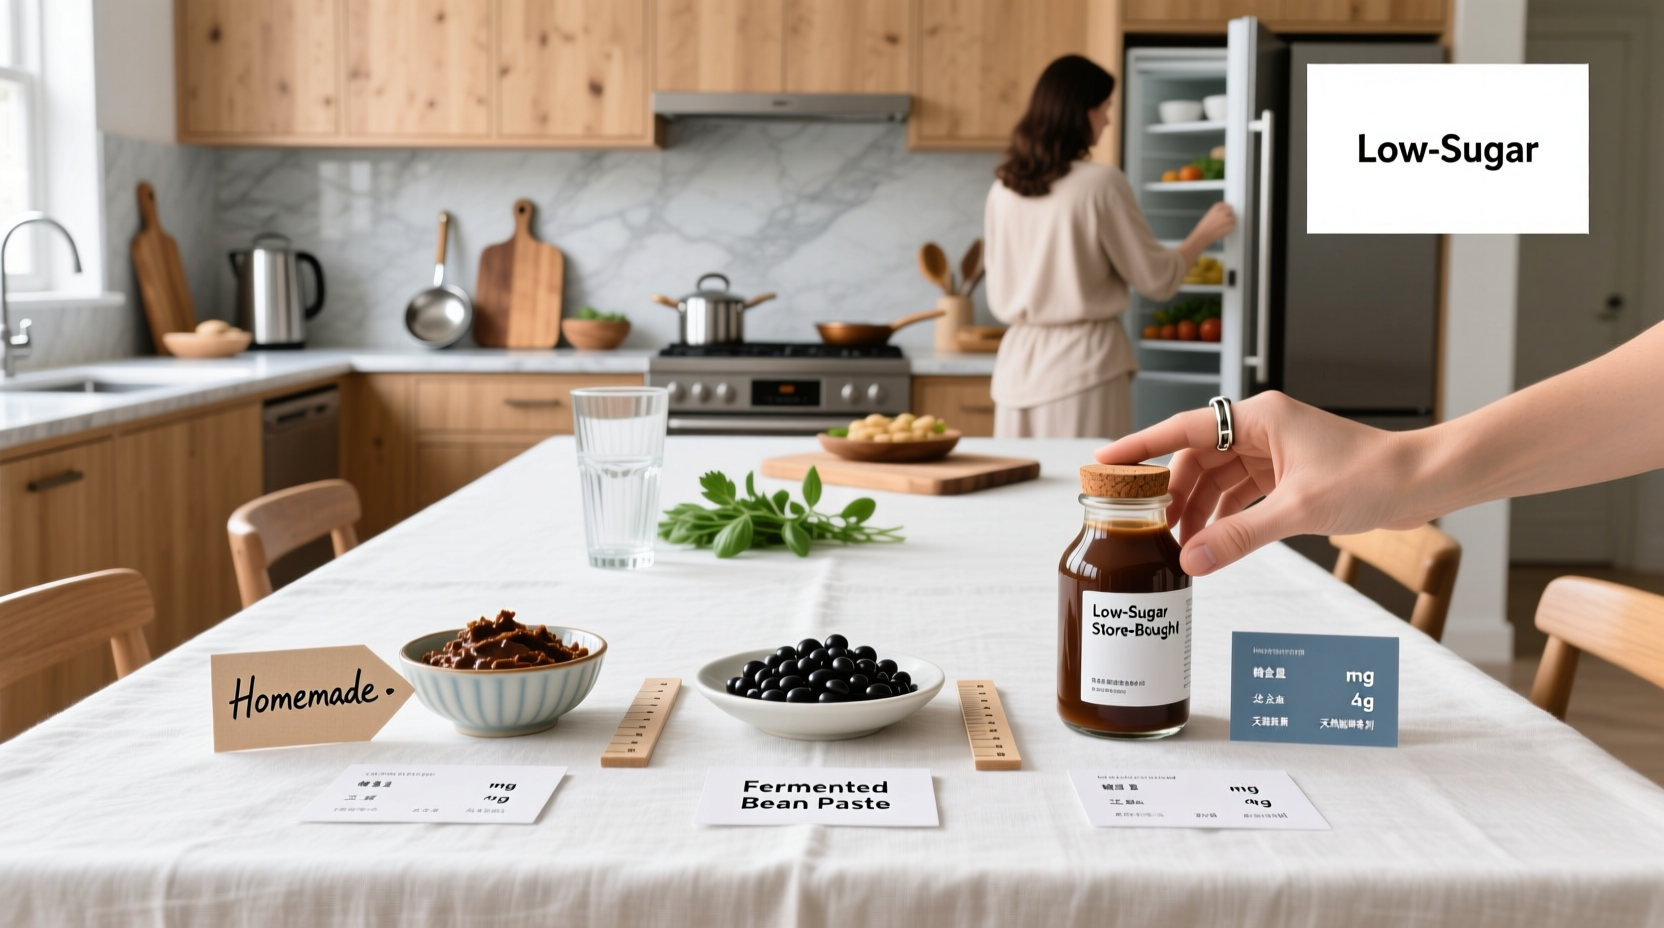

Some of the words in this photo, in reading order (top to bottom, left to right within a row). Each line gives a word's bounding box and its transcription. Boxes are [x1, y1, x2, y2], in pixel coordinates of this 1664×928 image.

[1093, 603, 1168, 622] Low-Sugar
[1346, 670, 1375, 688] mg
[743, 780, 889, 794] Fermented
[741, 796, 809, 810] Bean
[818, 796, 891, 810] Paste
